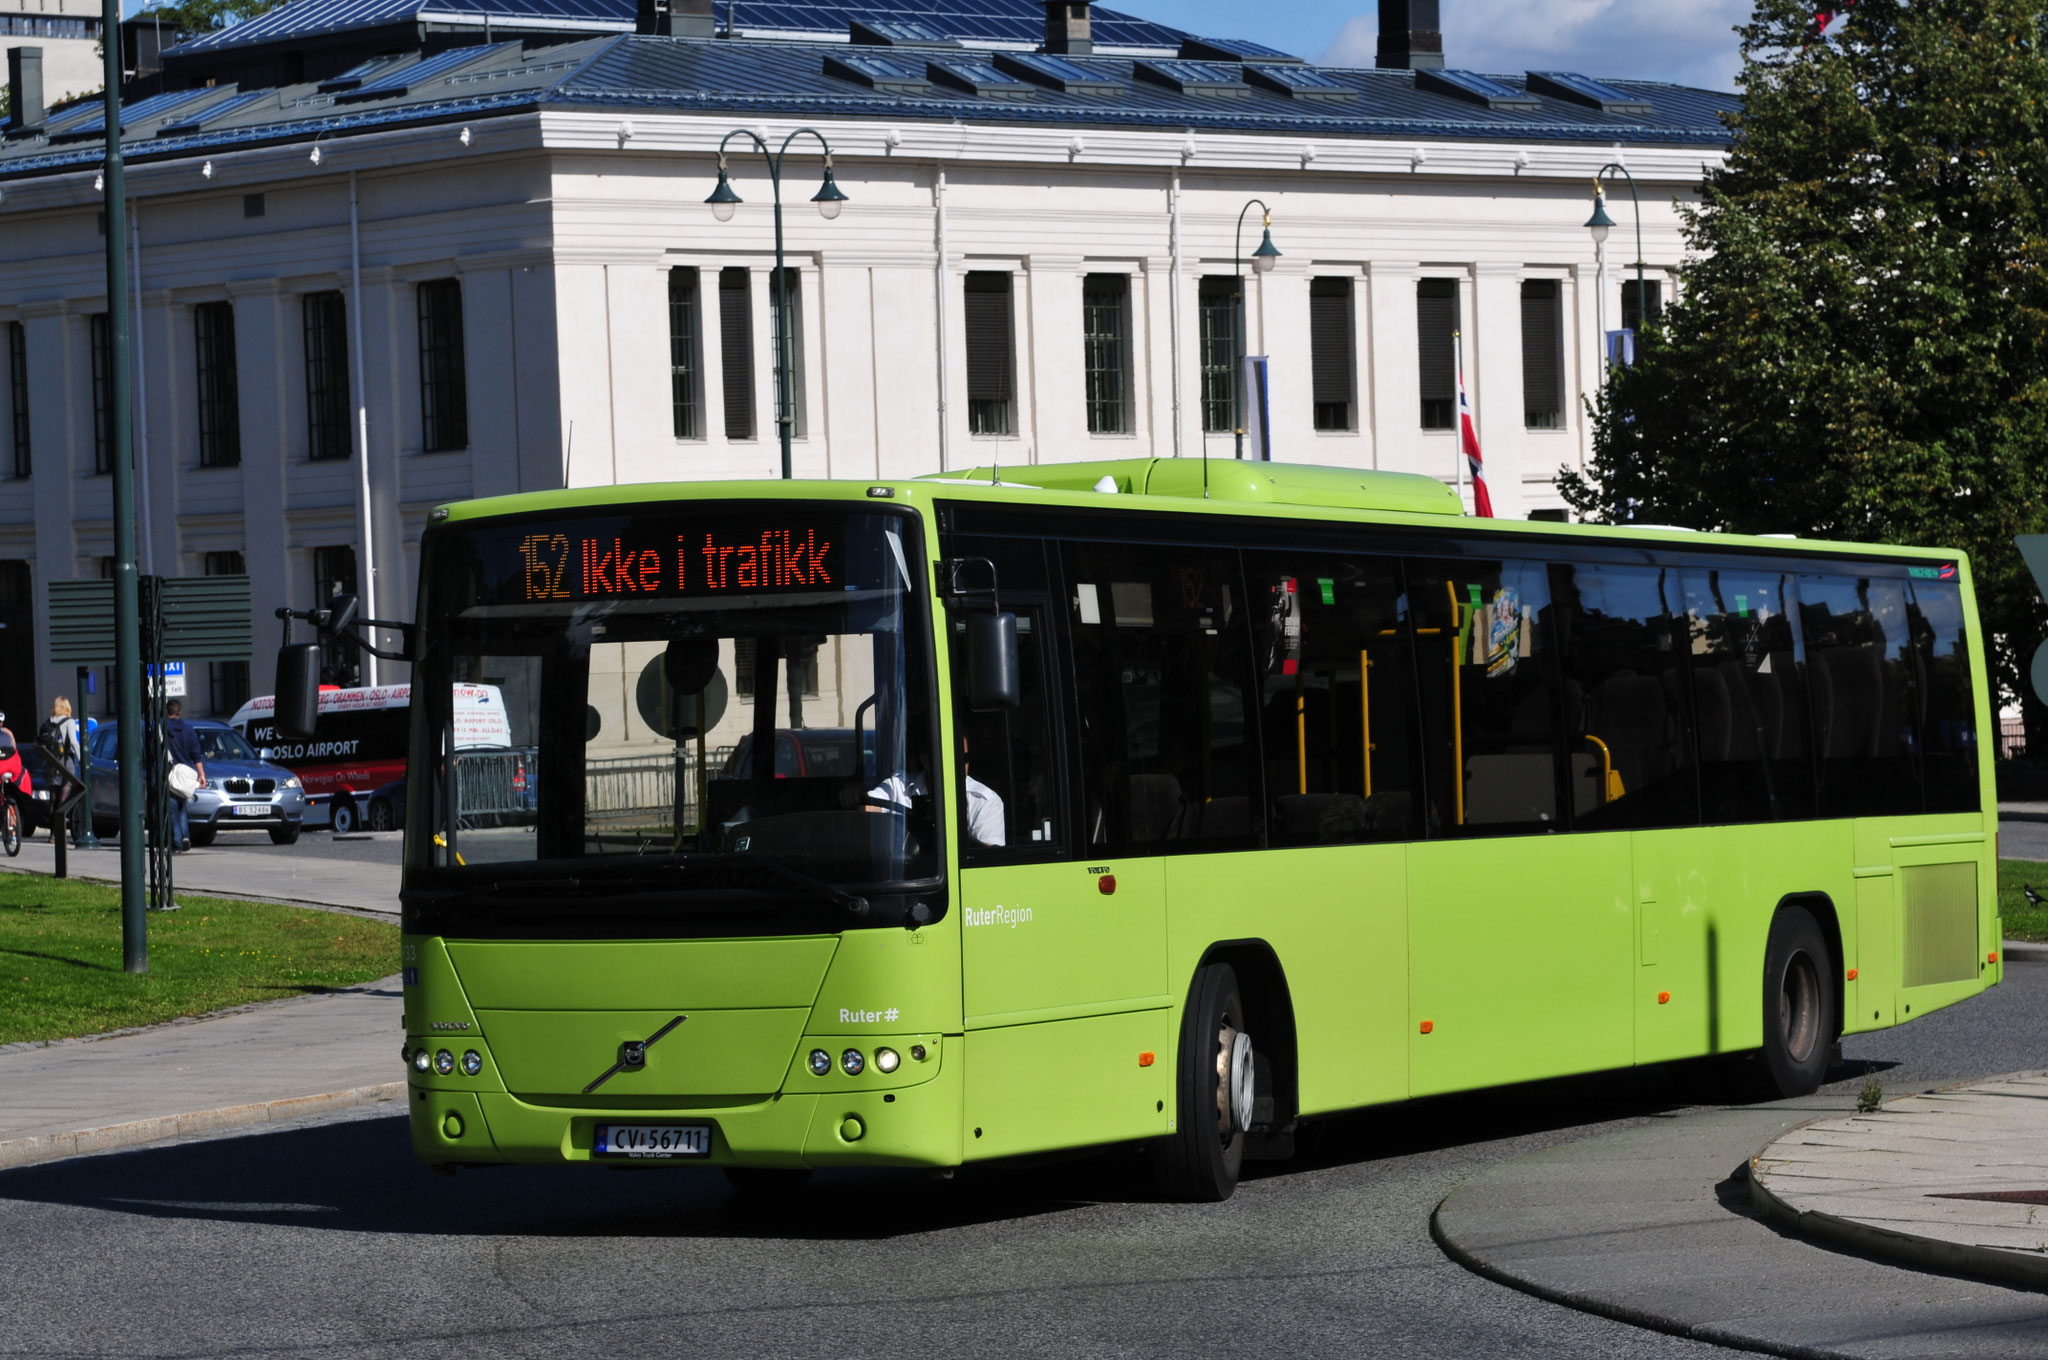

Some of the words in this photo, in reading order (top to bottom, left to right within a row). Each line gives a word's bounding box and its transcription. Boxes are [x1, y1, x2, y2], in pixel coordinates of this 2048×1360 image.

[519, 534, 570, 599] 152
[582, 537, 660, 594] Ikke
[677, 534, 685, 590] i
[702, 528, 831, 589] trafikk
[370, 689, 388, 701] OSLO
[254, 727, 273, 741] WE
[272, 744, 304, 759] OSLO
[306, 740, 359, 757] AIRPORT
[1087, 866, 1110, 874] VOLVO
[432, 1021, 470, 1030] VOLVO
[615, 1129, 639, 1149] CV
[648, 1129, 702, 1150] 56711
